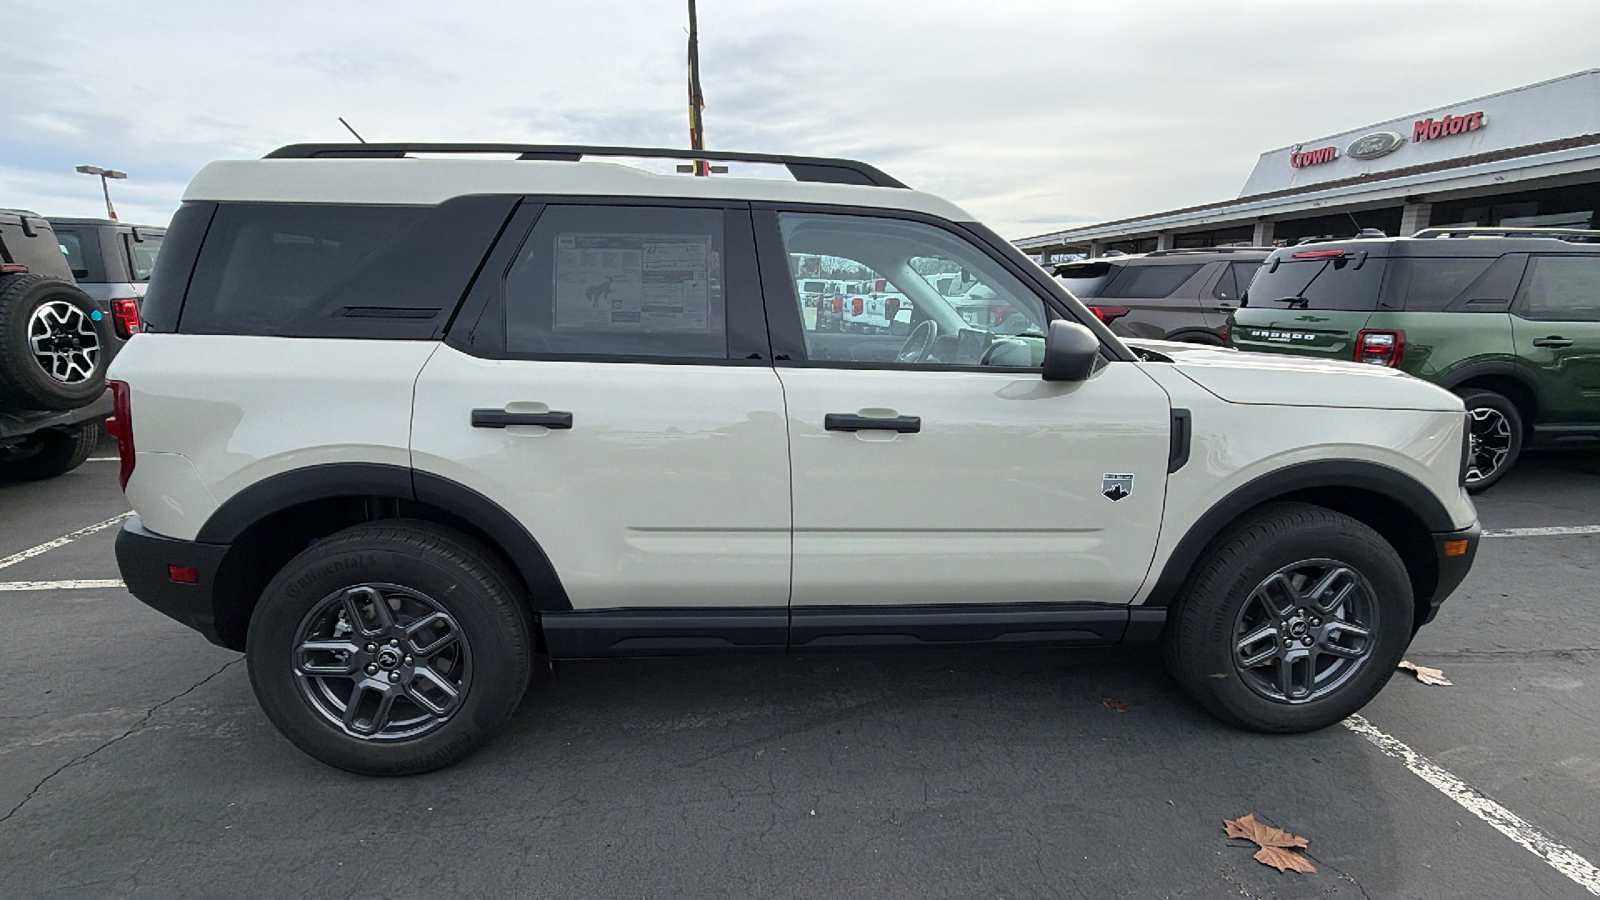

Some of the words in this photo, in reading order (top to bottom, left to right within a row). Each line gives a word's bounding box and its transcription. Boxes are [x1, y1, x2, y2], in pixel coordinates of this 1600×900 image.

[1290, 146, 1335, 168] Crown
[1356, 137, 1385, 154] Ford
[1413, 111, 1483, 143] Motors
[646, 245, 657, 254] 27
[1251, 331, 1315, 340] BRONCO
[286, 554, 363, 597] Continental
